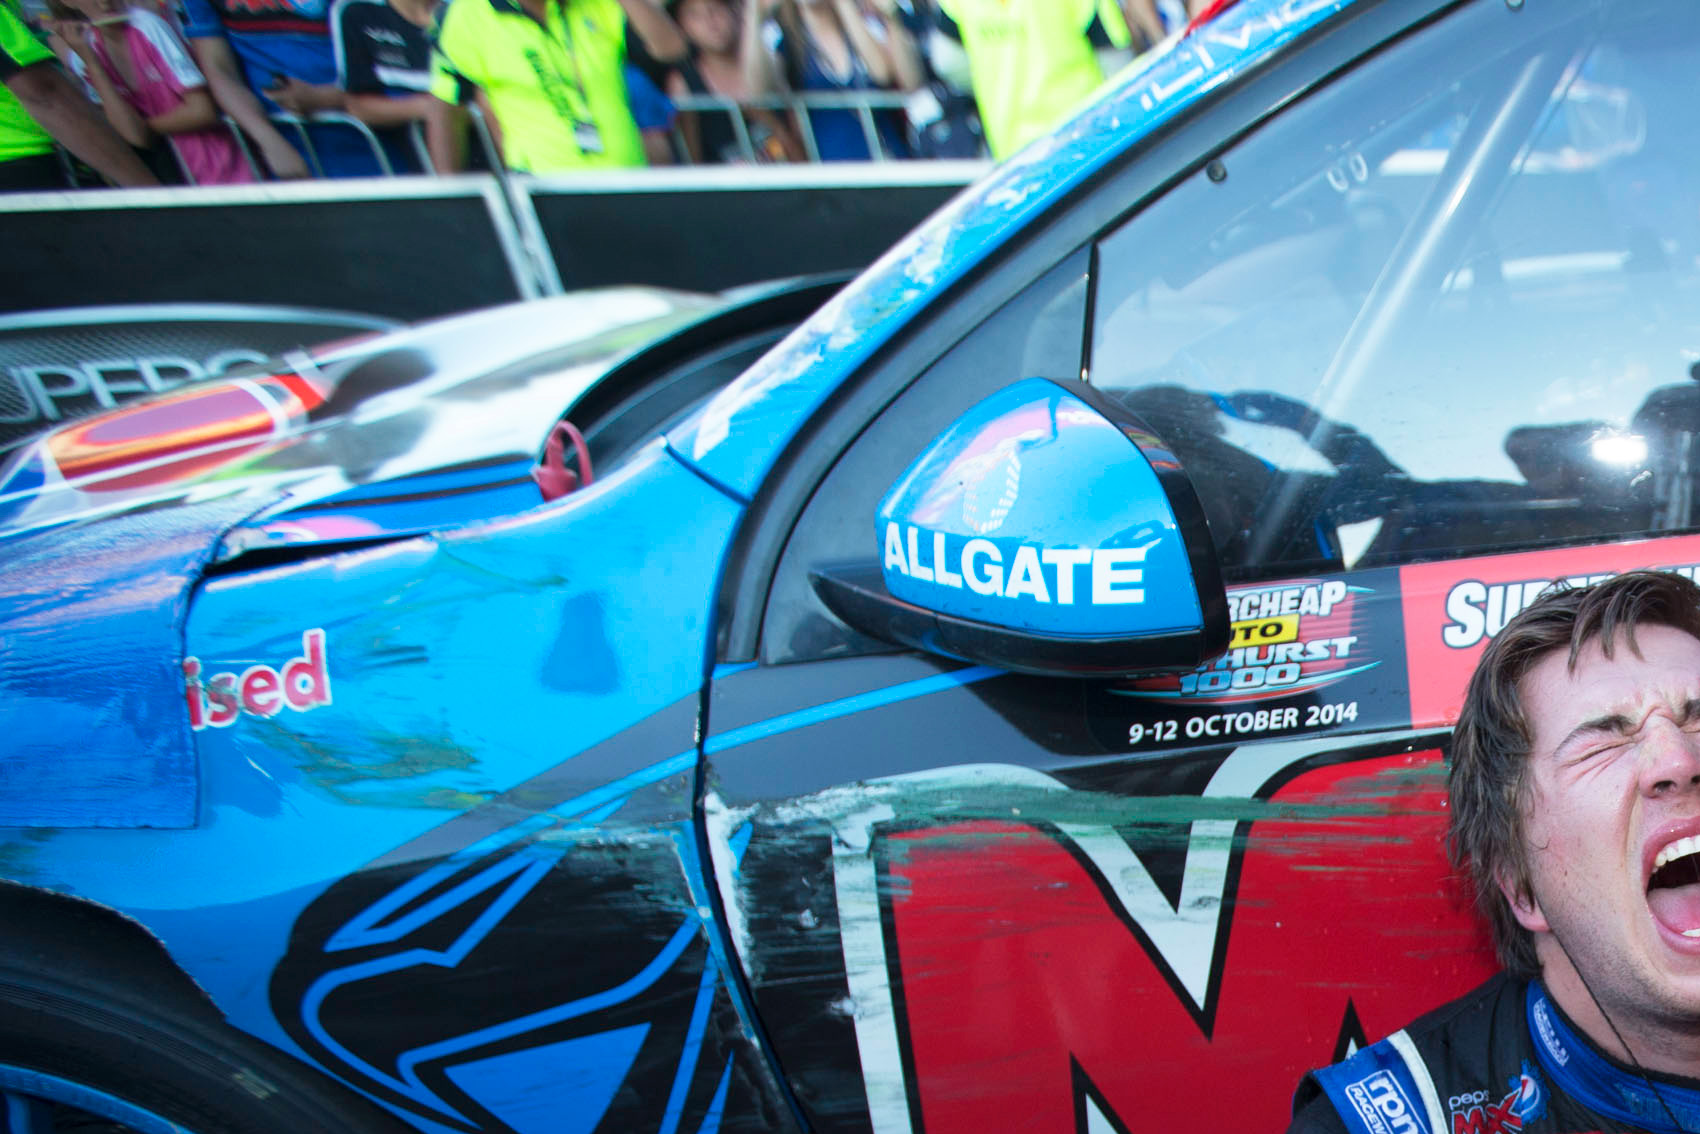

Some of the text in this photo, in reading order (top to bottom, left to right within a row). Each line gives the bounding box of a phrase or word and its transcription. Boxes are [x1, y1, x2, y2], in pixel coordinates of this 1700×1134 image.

[884, 521, 1147, 605] ALLGATE
[1197, 636, 1358, 671] HURST
[1179, 664, 1302, 695] 1000
[1129, 702, 1358, 744] 9-12 OCTOBER 2014
